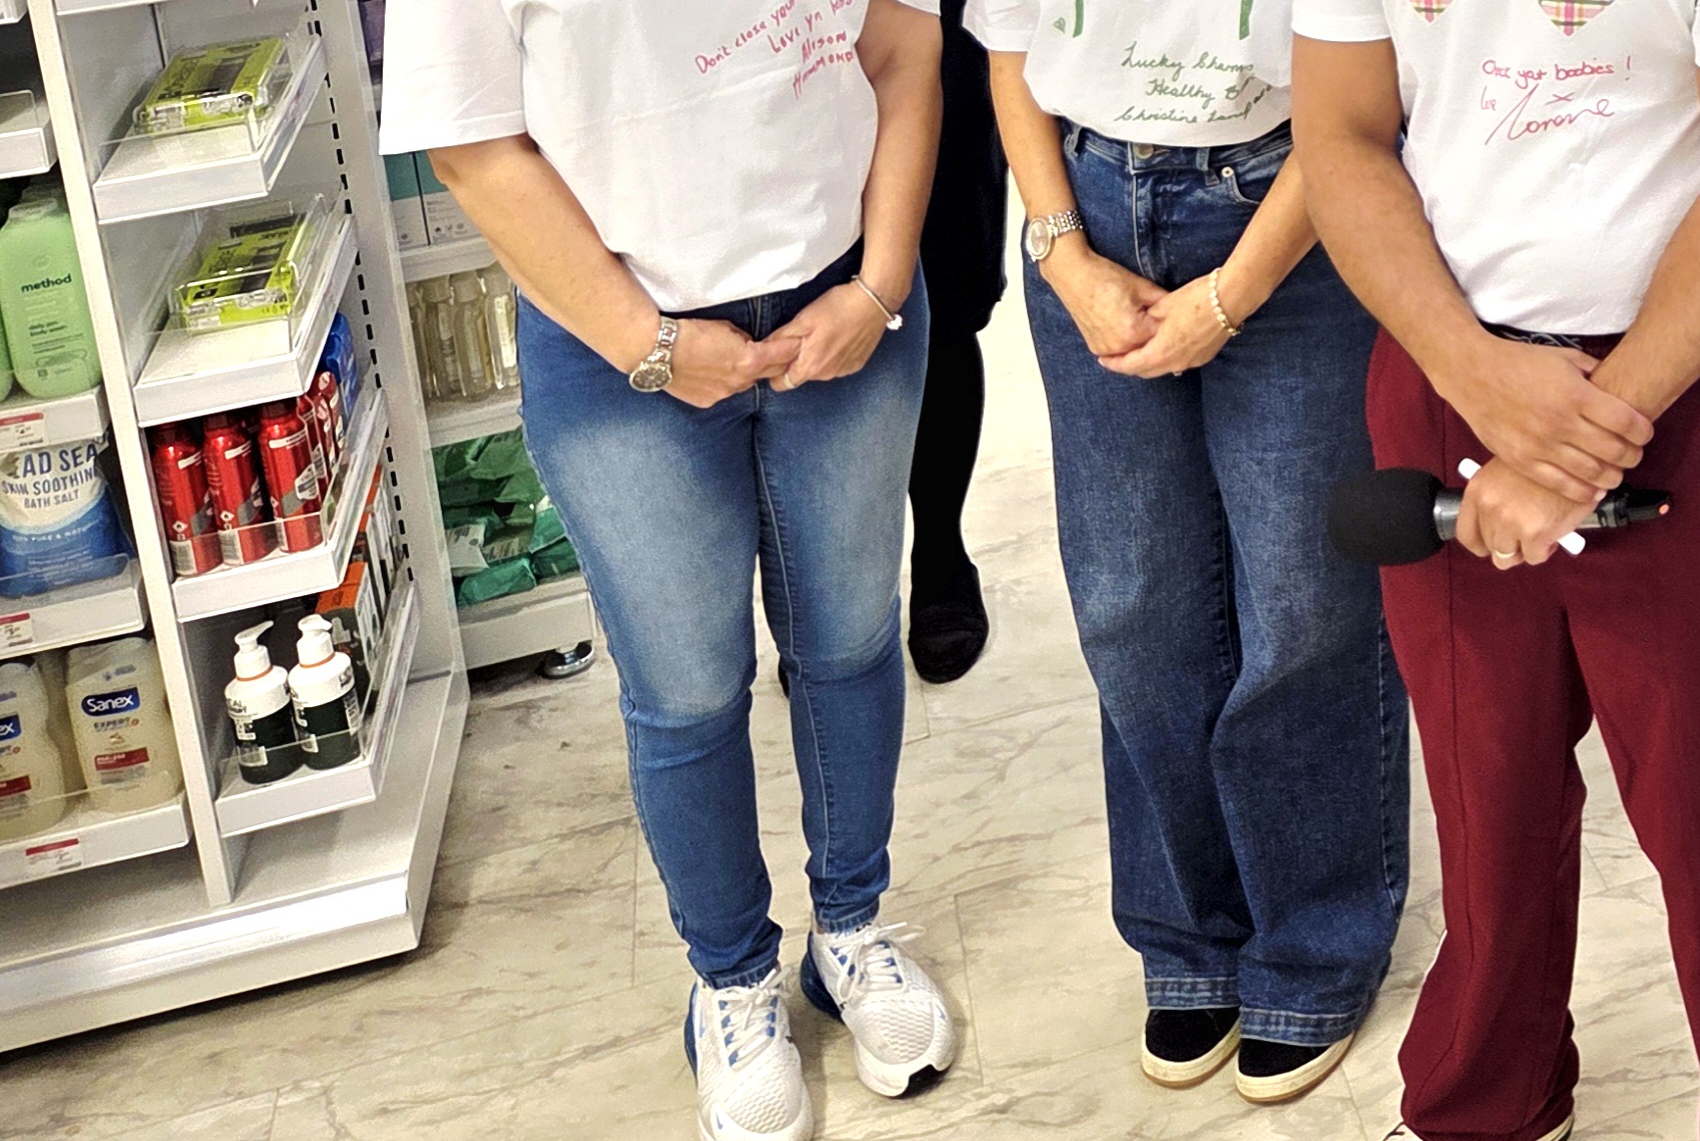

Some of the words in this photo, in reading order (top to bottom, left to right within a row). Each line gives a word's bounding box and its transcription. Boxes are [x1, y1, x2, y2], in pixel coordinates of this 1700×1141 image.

[695, 45, 731, 74] Don't
[735, 21, 767, 48] close
[1121, 41, 1185, 82] Lucky
[1192, 52, 1254, 73] Charms
[1555, 57, 1614, 81] boobies
[1146, 78, 1216, 109] Healthy
[1114, 105, 1198, 123] Christine
[21, 273, 72, 293] method
[59, 443, 98, 472] SEA
[2, 480, 29, 496] SKIN
[24, 497, 51, 509] BATH
[54, 489, 79, 505] SALT
[86, 694, 134, 712] Sanex
